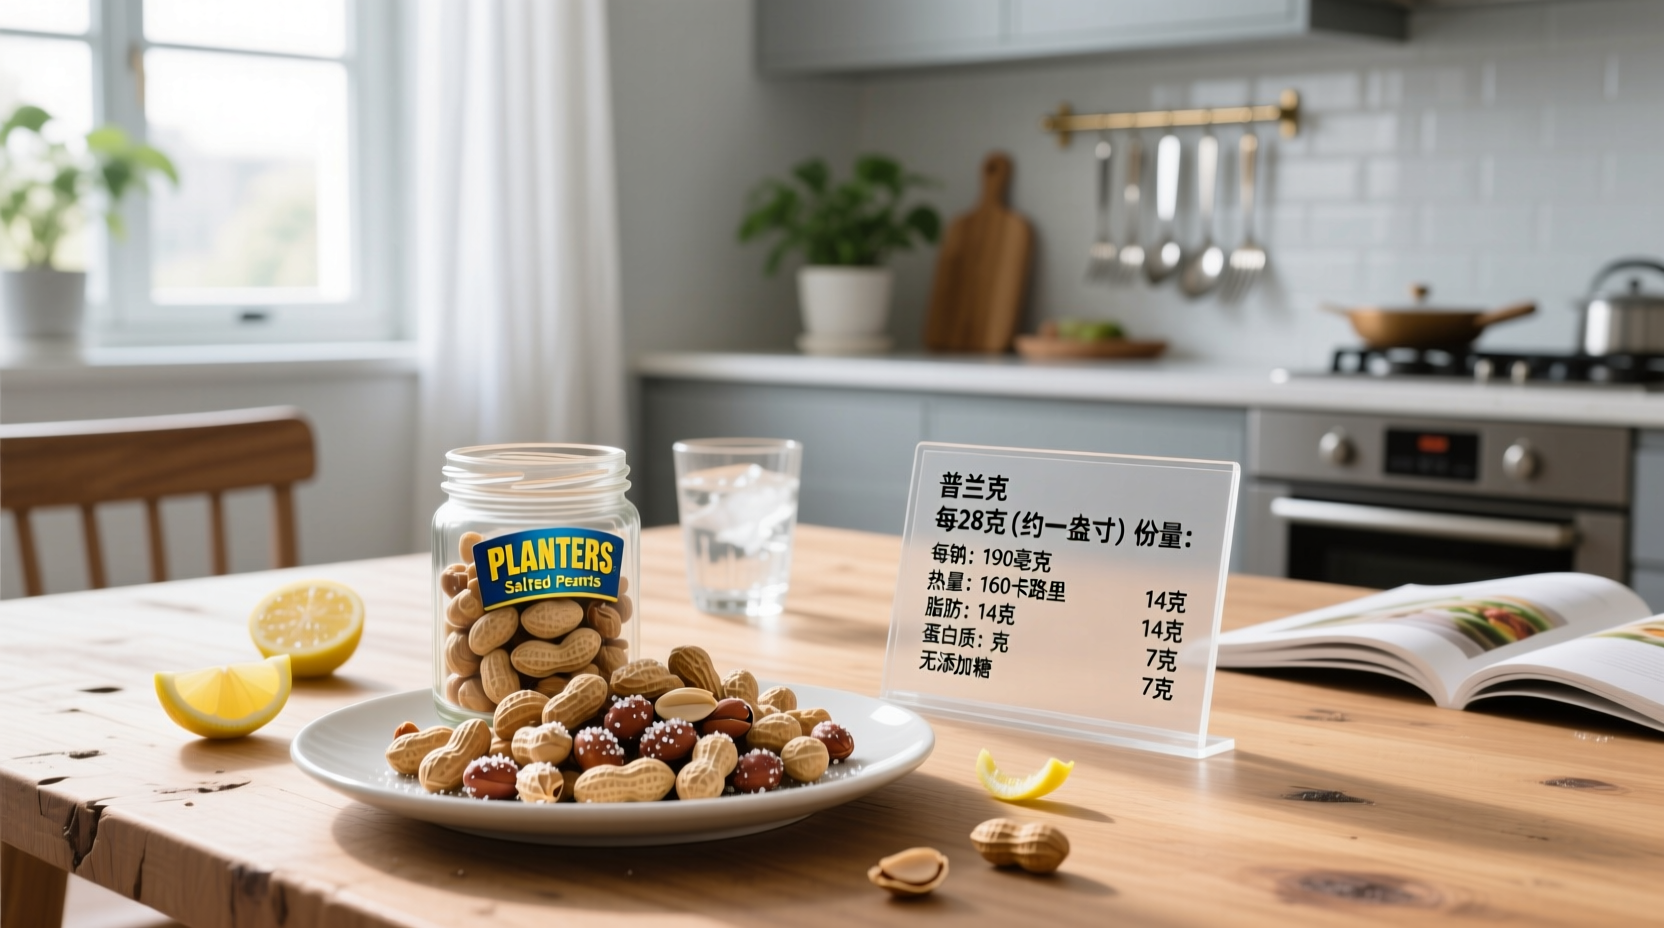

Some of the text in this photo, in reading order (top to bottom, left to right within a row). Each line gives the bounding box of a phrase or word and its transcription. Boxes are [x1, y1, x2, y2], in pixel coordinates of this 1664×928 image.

[939, 471, 1010, 502] 普兰克
[487, 536, 614, 582] PLANTERS
[1145, 589, 1188, 614] 14克
[1142, 618, 1185, 644] 14克
[919, 649, 993, 679] 无添加糖
[1146, 647, 1178, 673] 7克
[1142, 676, 1175, 701] 7克
